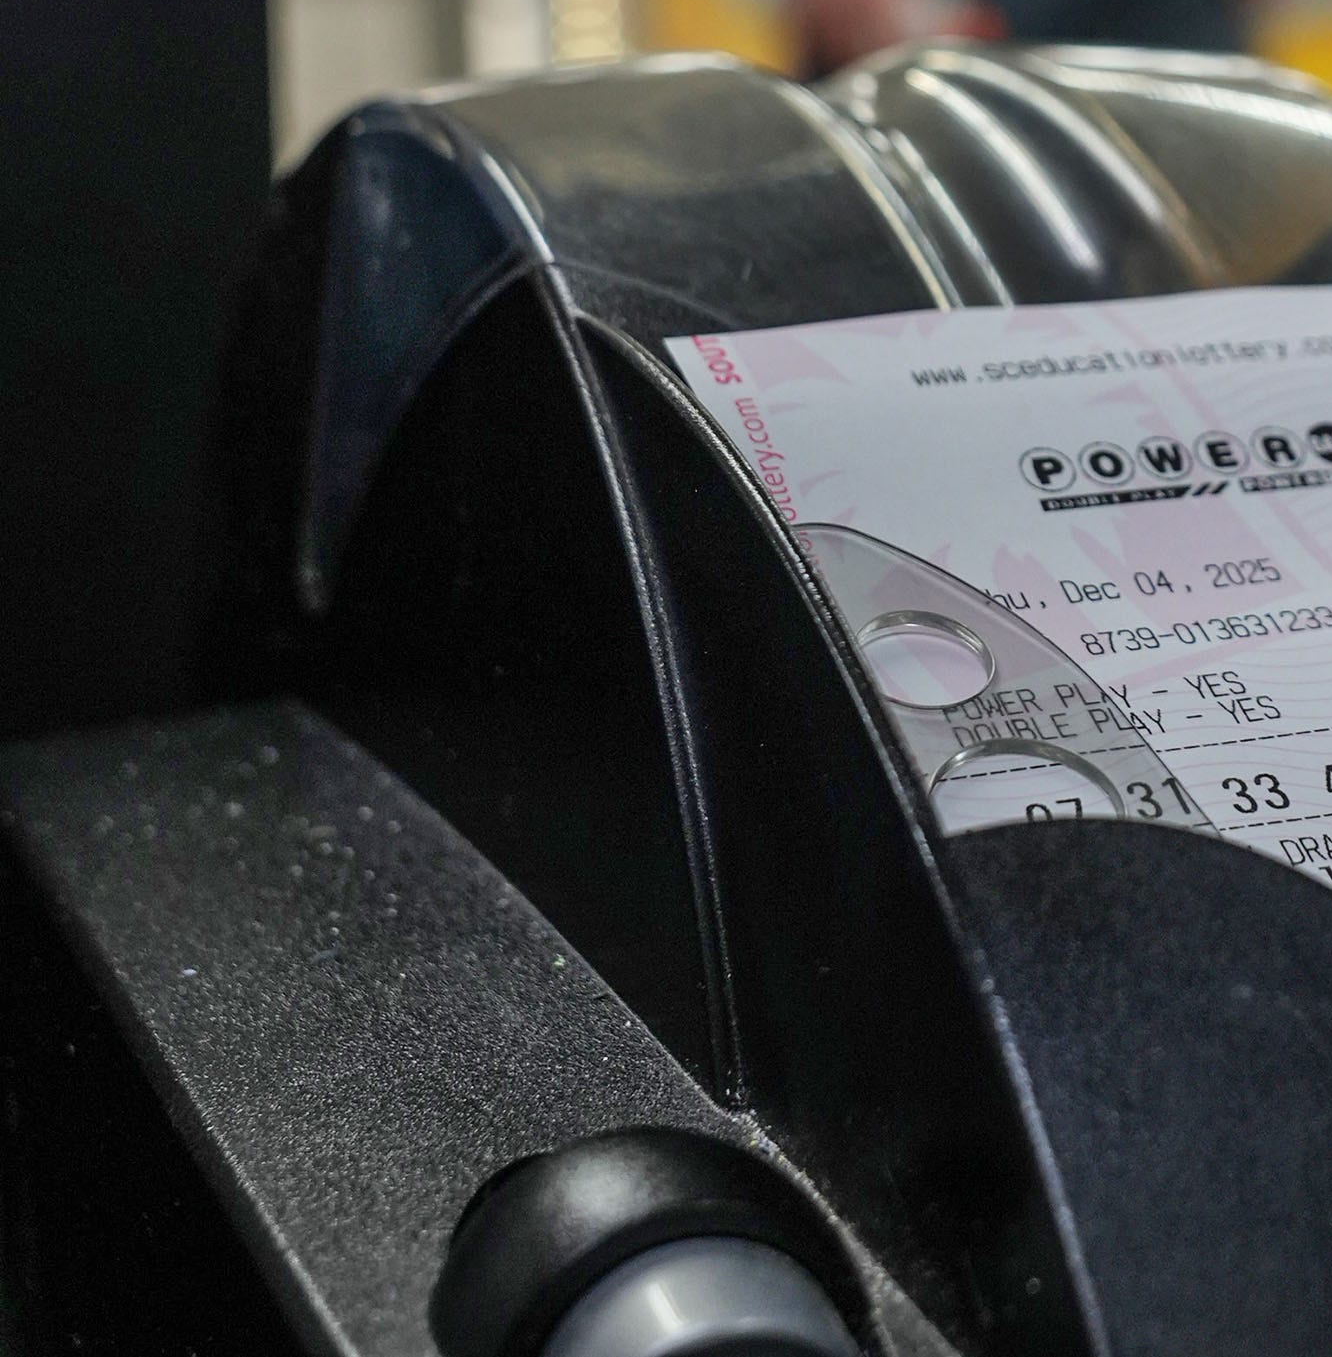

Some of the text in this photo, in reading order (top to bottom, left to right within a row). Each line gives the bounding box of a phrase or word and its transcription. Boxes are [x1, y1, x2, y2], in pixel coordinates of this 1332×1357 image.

[985, 589, 1047, 610] hu,
[1060, 580, 1121, 604] Dec
[1204, 558, 1281, 587] 2025
[1053, 683, 1131, 708] PLAY
[1183, 671, 1246, 699] YES
[953, 713, 1078, 749] DOUBLE
[1089, 708, 1166, 735] PLAY
[1218, 695, 1281, 724] YES
[1127, 777, 1191, 820] 31
[1222, 773, 1290, 814] 33
